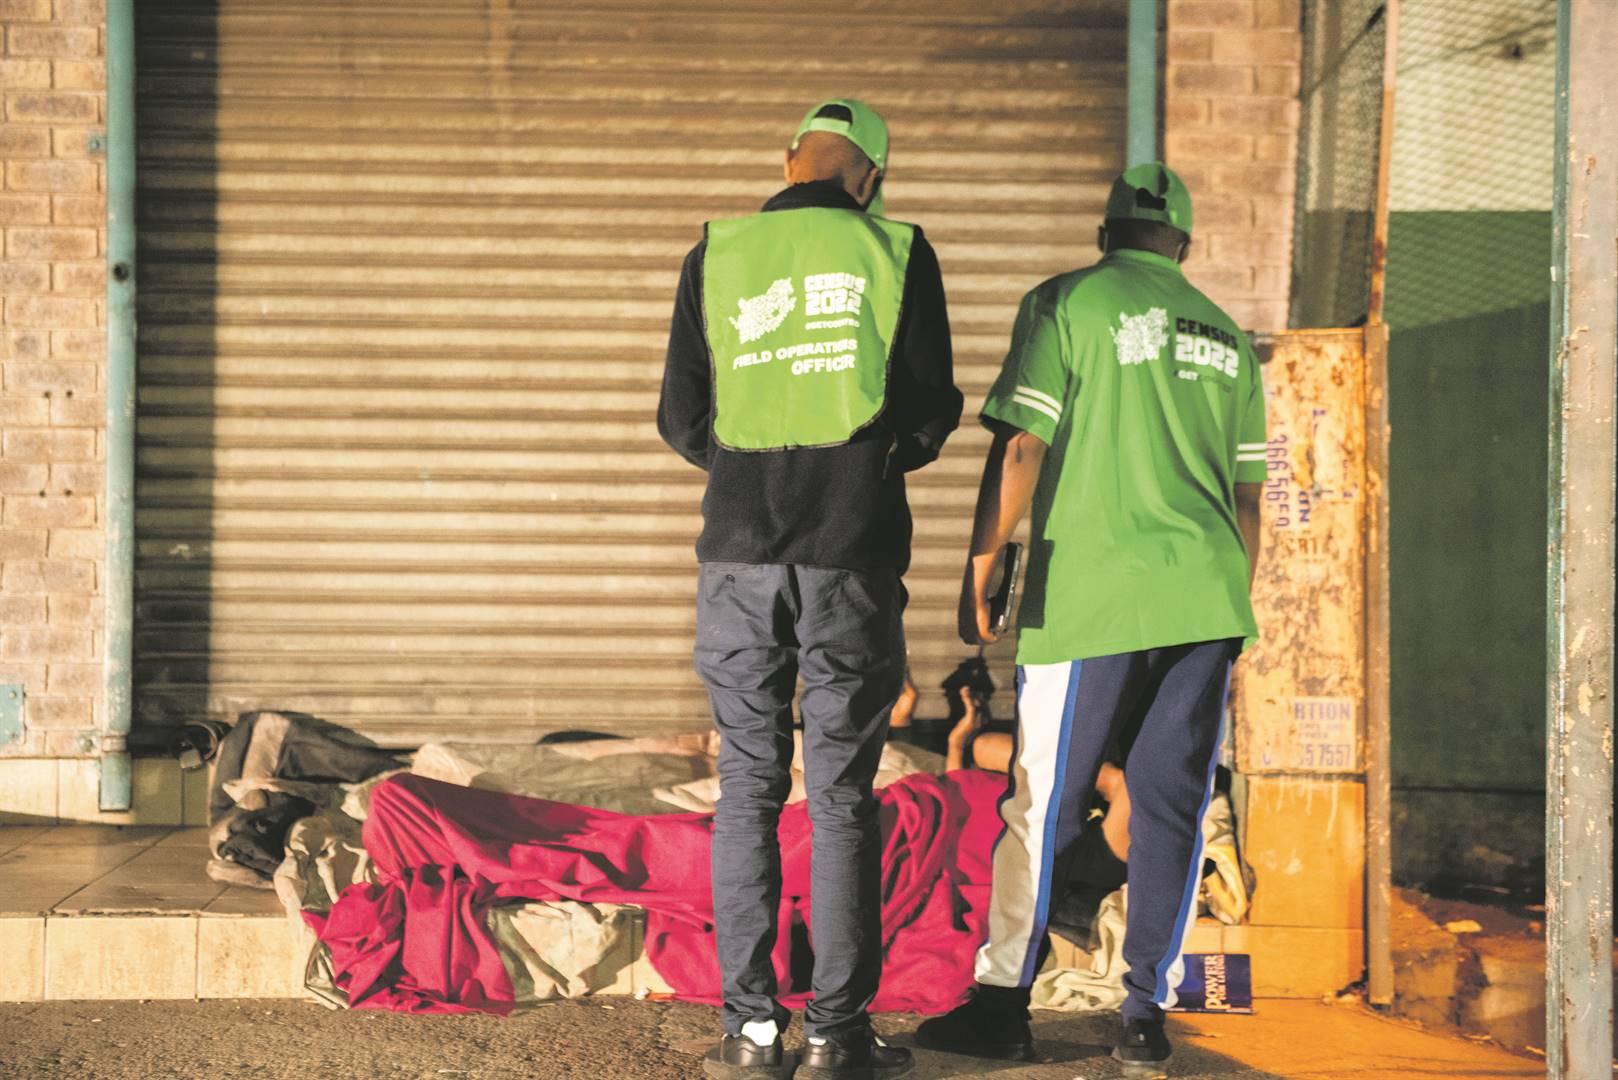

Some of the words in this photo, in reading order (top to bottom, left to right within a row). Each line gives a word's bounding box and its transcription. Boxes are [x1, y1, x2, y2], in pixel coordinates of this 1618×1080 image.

[805, 288, 862, 316] 2022
[1176, 317, 1238, 350] CENSUS
[1175, 333, 1239, 378] 2022
[1204, 954, 1231, 1009] POWER
